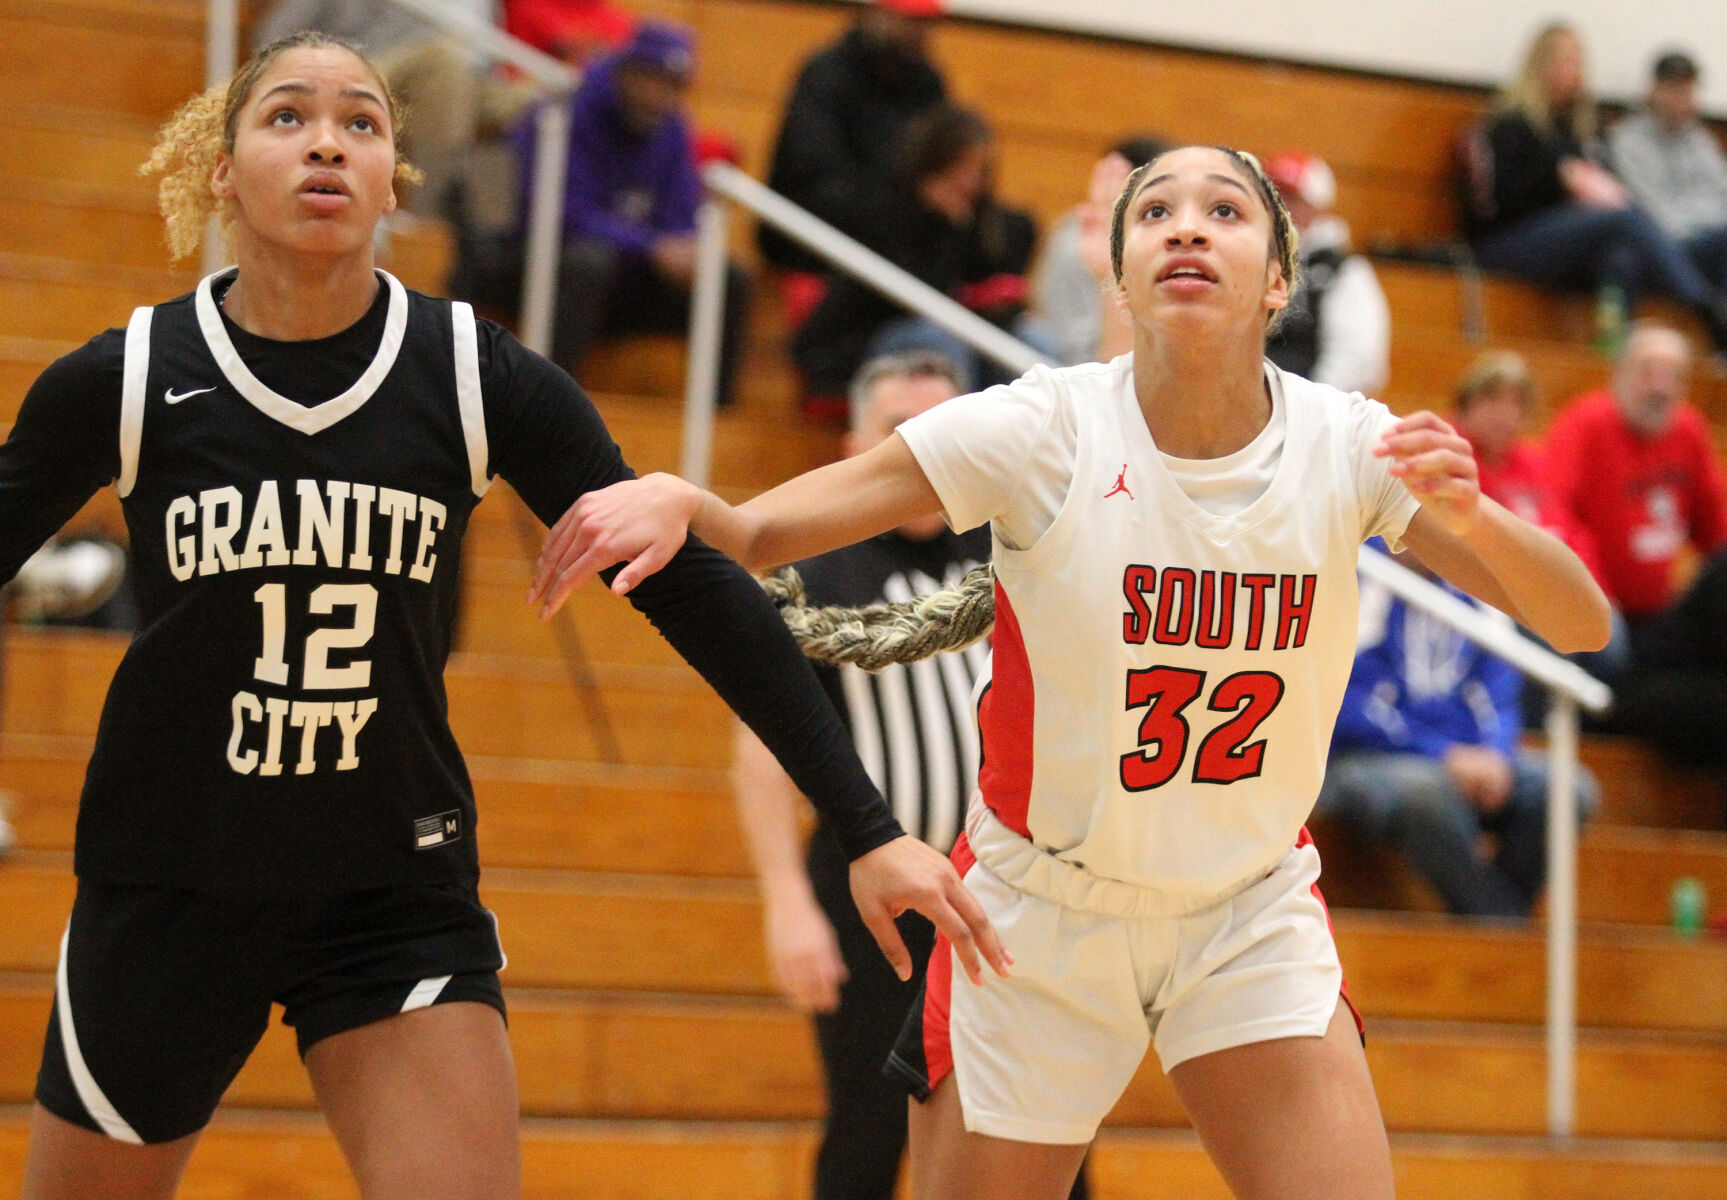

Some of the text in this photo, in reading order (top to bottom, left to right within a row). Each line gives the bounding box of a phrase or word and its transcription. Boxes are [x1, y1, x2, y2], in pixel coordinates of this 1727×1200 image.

[166, 479, 447, 584] GRANITE
[253, 583, 379, 690] 12
[1123, 564, 1318, 651] SOUTH
[226, 690, 378, 776] CITY
[1119, 665, 1285, 793] 32
[446, 819, 457, 834] M
